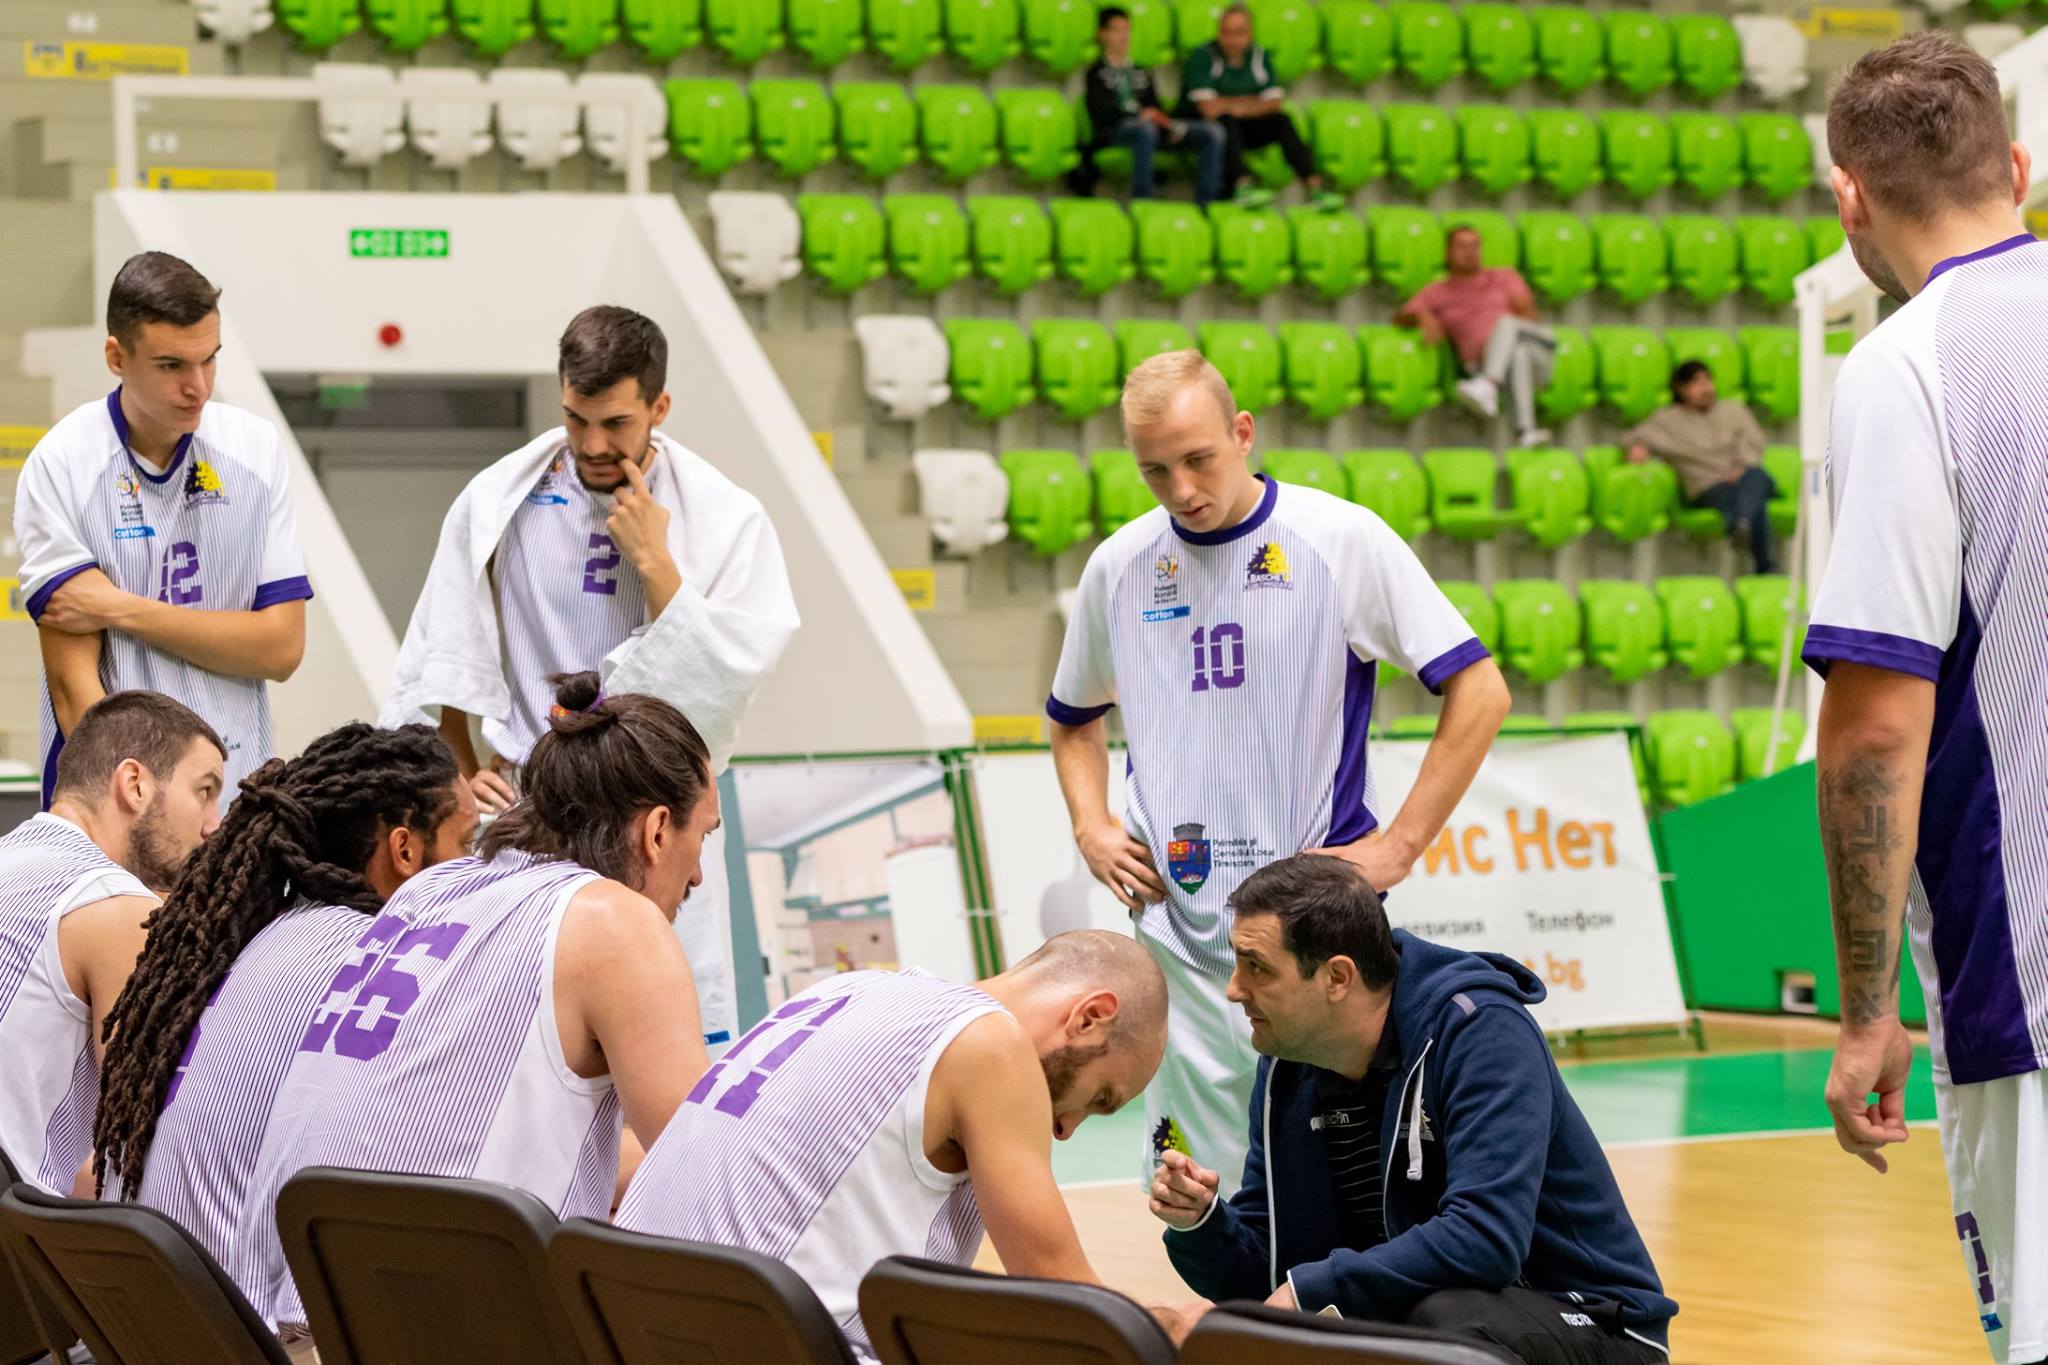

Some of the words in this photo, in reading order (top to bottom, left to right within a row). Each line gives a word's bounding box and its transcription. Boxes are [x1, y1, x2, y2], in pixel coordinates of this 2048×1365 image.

[158, 541, 203, 605] 12
[583, 533, 621, 595] 2
[1191, 623, 1245, 692] 10
[1420, 825, 1494, 876] ис
[1505, 807, 1617, 872] Нет
